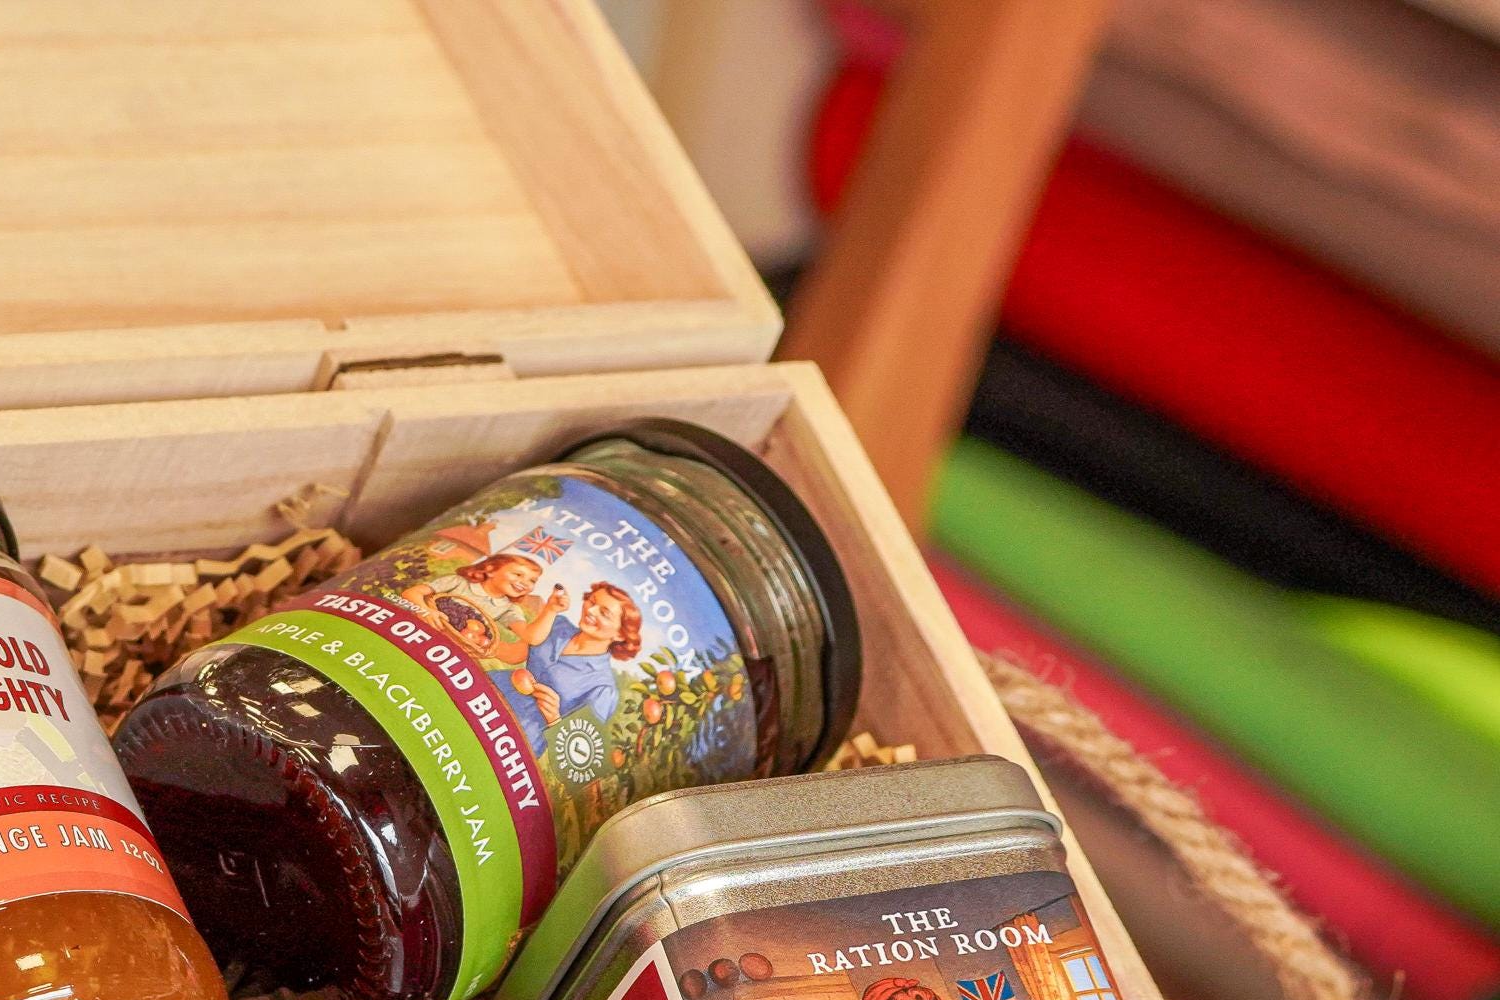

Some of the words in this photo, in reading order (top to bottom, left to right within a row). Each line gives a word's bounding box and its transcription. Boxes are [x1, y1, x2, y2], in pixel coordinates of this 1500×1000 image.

[612, 518, 677, 585] THE
[512, 497, 637, 571] RATION
[633, 576, 703, 683] ROOM
[313, 593, 396, 625] TASTE
[390, 620, 432, 644] OF
[425, 644, 475, 691] OLD
[466, 692, 540, 811] BLIGHTY
[256, 622, 325, 645] APPLE
[320, 639, 344, 656] &
[343, 651, 473, 794] BLACKBERRY
[460, 803, 495, 867] JAM
[555, 726, 570, 770] RECIPE
[569, 718, 605, 768] AUTHENTIC
[36, 792, 102, 811] RECIPE
[57, 823, 115, 852] JAM
[881, 907, 959, 935] THE
[806, 936, 940, 975] RATION
[949, 923, 1053, 956] ROOM
